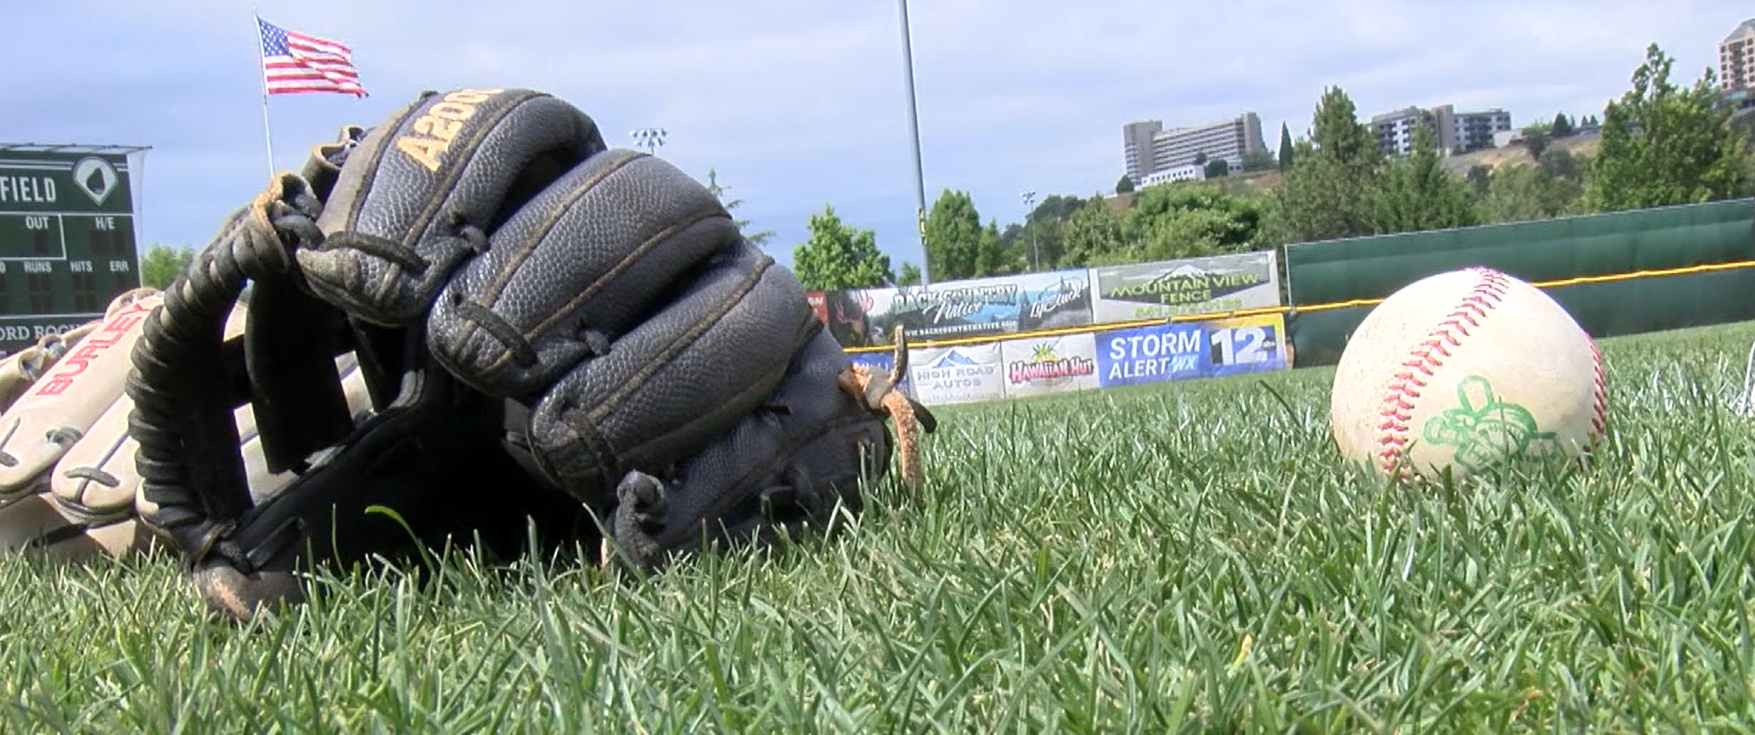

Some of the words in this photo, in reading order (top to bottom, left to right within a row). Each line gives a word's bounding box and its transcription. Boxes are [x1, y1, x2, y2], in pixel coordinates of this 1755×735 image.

[1, 176, 57, 202] FIELD
[25, 216, 50, 230] OUT
[95, 216, 116, 231] H/E
[24, 260, 52, 273] RUNS
[70, 260, 93, 272] HITS
[109, 260, 130, 272] ERR
[1110, 278, 1209, 298] MOUNTAIN
[1212, 273, 1259, 287] VIEW
[1160, 289, 1212, 304] FENCE
[922, 299, 984, 324] Native
[35, 303, 151, 396] BURLEY
[1109, 329, 1202, 360] STORM
[1211, 327, 1267, 366] 12
[917, 367, 951, 381] HIGH
[956, 366, 994, 378] ROAD
[1068, 356, 1095, 376] HUT
[1109, 357, 1170, 380] ALERT
[933, 379, 982, 390] AUTOS
